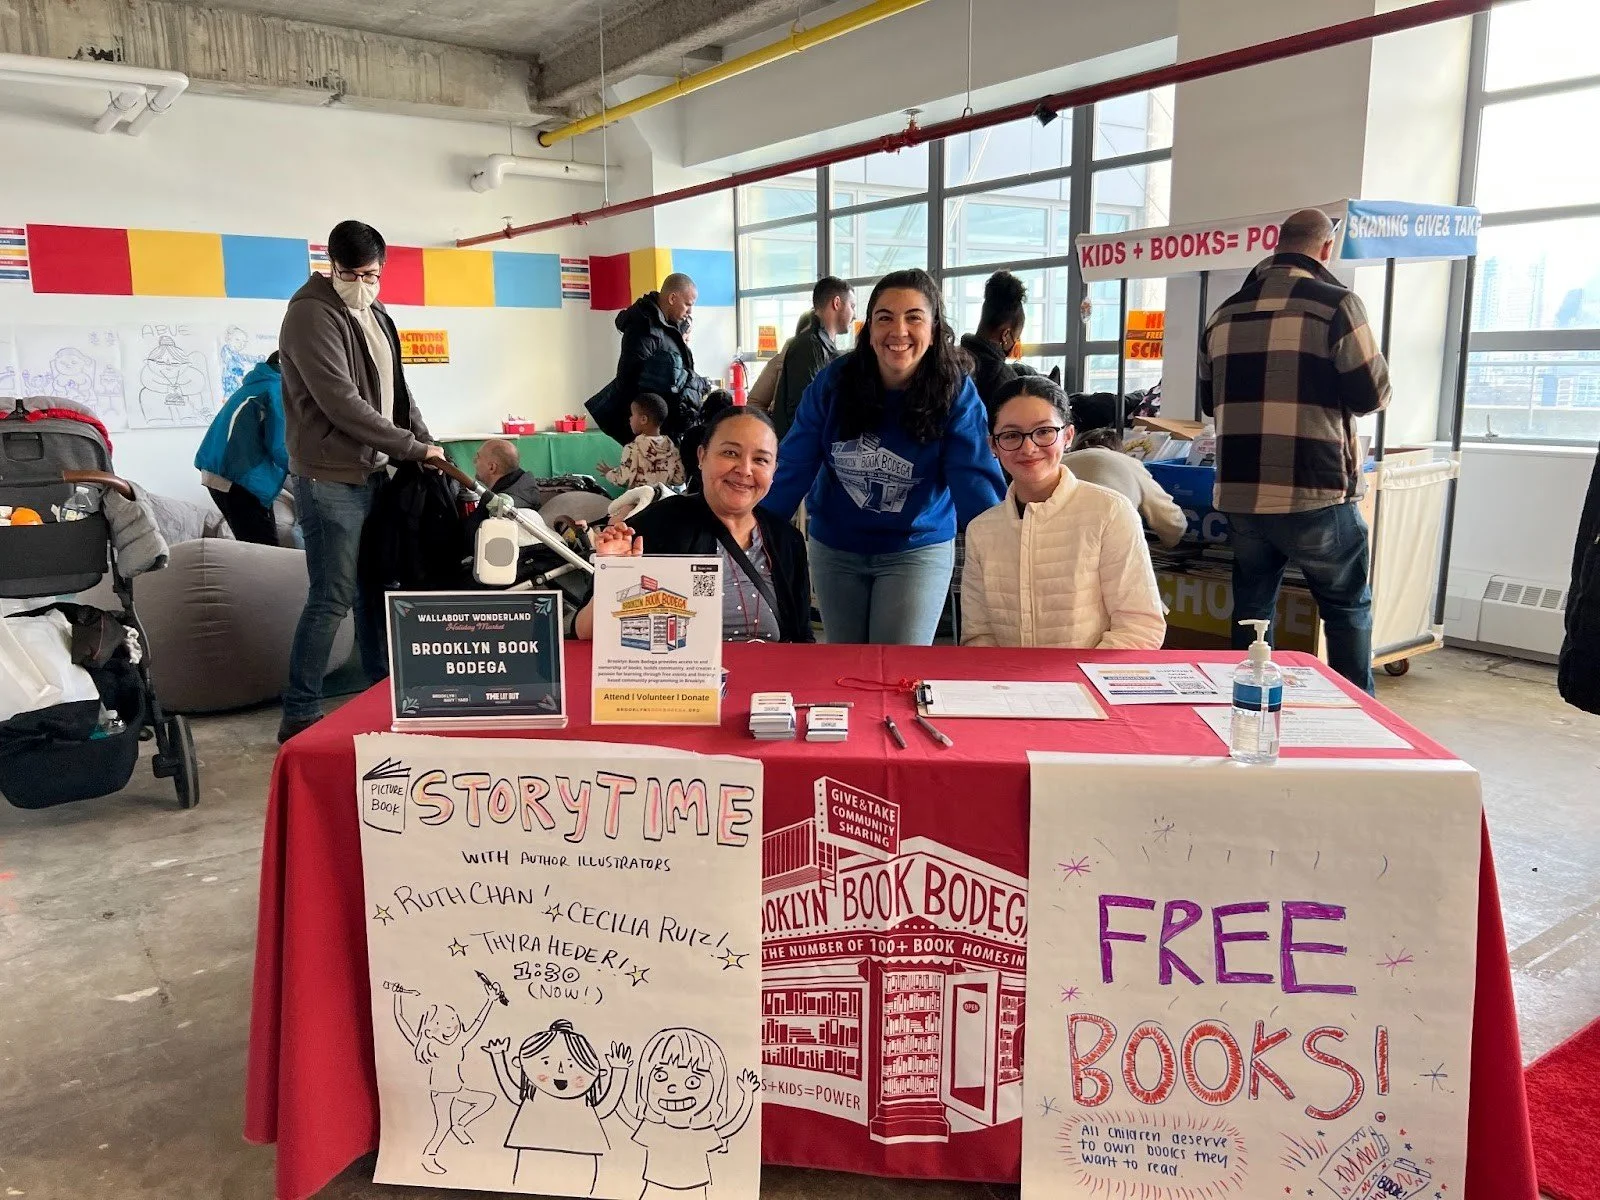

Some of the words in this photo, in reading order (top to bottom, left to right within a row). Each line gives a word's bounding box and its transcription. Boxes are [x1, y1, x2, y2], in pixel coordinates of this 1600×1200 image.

[1349, 214, 1409, 239] SHARING
[1081, 242, 1126, 268] KIDS
[1246, 224, 1280, 252] PO
[412, 343, 445, 356] ROOM
[861, 454, 880, 468] BOOK
[881, 454, 911, 478] BODEGA
[417, 613, 470, 622] WALLABOUT
[472, 612, 531, 622] WONDERLAND
[412, 641, 490, 655] BROOKLYN
[498, 641, 539, 654] BOOK
[446, 661, 507, 674] BODEGA
[636, 693, 675, 701] Volunteer
[681, 693, 710, 701] Donate
[371, 783, 404, 796] PICTURE
[371, 800, 400, 815] BOOK
[411, 769, 755, 847] STORYTIME
[832, 805, 896, 837] COMMUNITY
[839, 821, 891, 848] SHARING
[461, 850, 509, 866] WITH
[520, 851, 569, 867] AUTHOR
[577, 854, 672, 872] ILLUSTRATORS
[394, 885, 466, 915] RUTH
[843, 858, 916, 921] BOOK
[567, 901, 650, 939] CECILIA
[470, 930, 541, 955] THYRA
[762, 946, 785, 960] THE
[789, 941, 843, 958] NUMBER
[847, 939, 864, 951] OF
[869, 939, 909, 954] 100+
[913, 937, 955, 954] BOOK
[961, 942, 1010, 964] HOMES
[1012, 953, 1026, 967] IN
[1099, 894, 1358, 995] FREE
[513, 961, 581, 983] 1:30
[528, 983, 604, 1005] (NOW!)
[1067, 1013, 1390, 1123] BOOKS!
[1081, 1124, 1100, 1136] All
[1108, 1127, 1161, 1142] children
[1172, 1132, 1229, 1148] deserve
[1078, 1139, 1096, 1151] to
[1104, 1141, 1135, 1154] own
[1147, 1144, 1186, 1160] books
[1194, 1150, 1229, 1169] they
[1081, 1152, 1118, 1168] want
[1123, 1158, 1138, 1170] to
